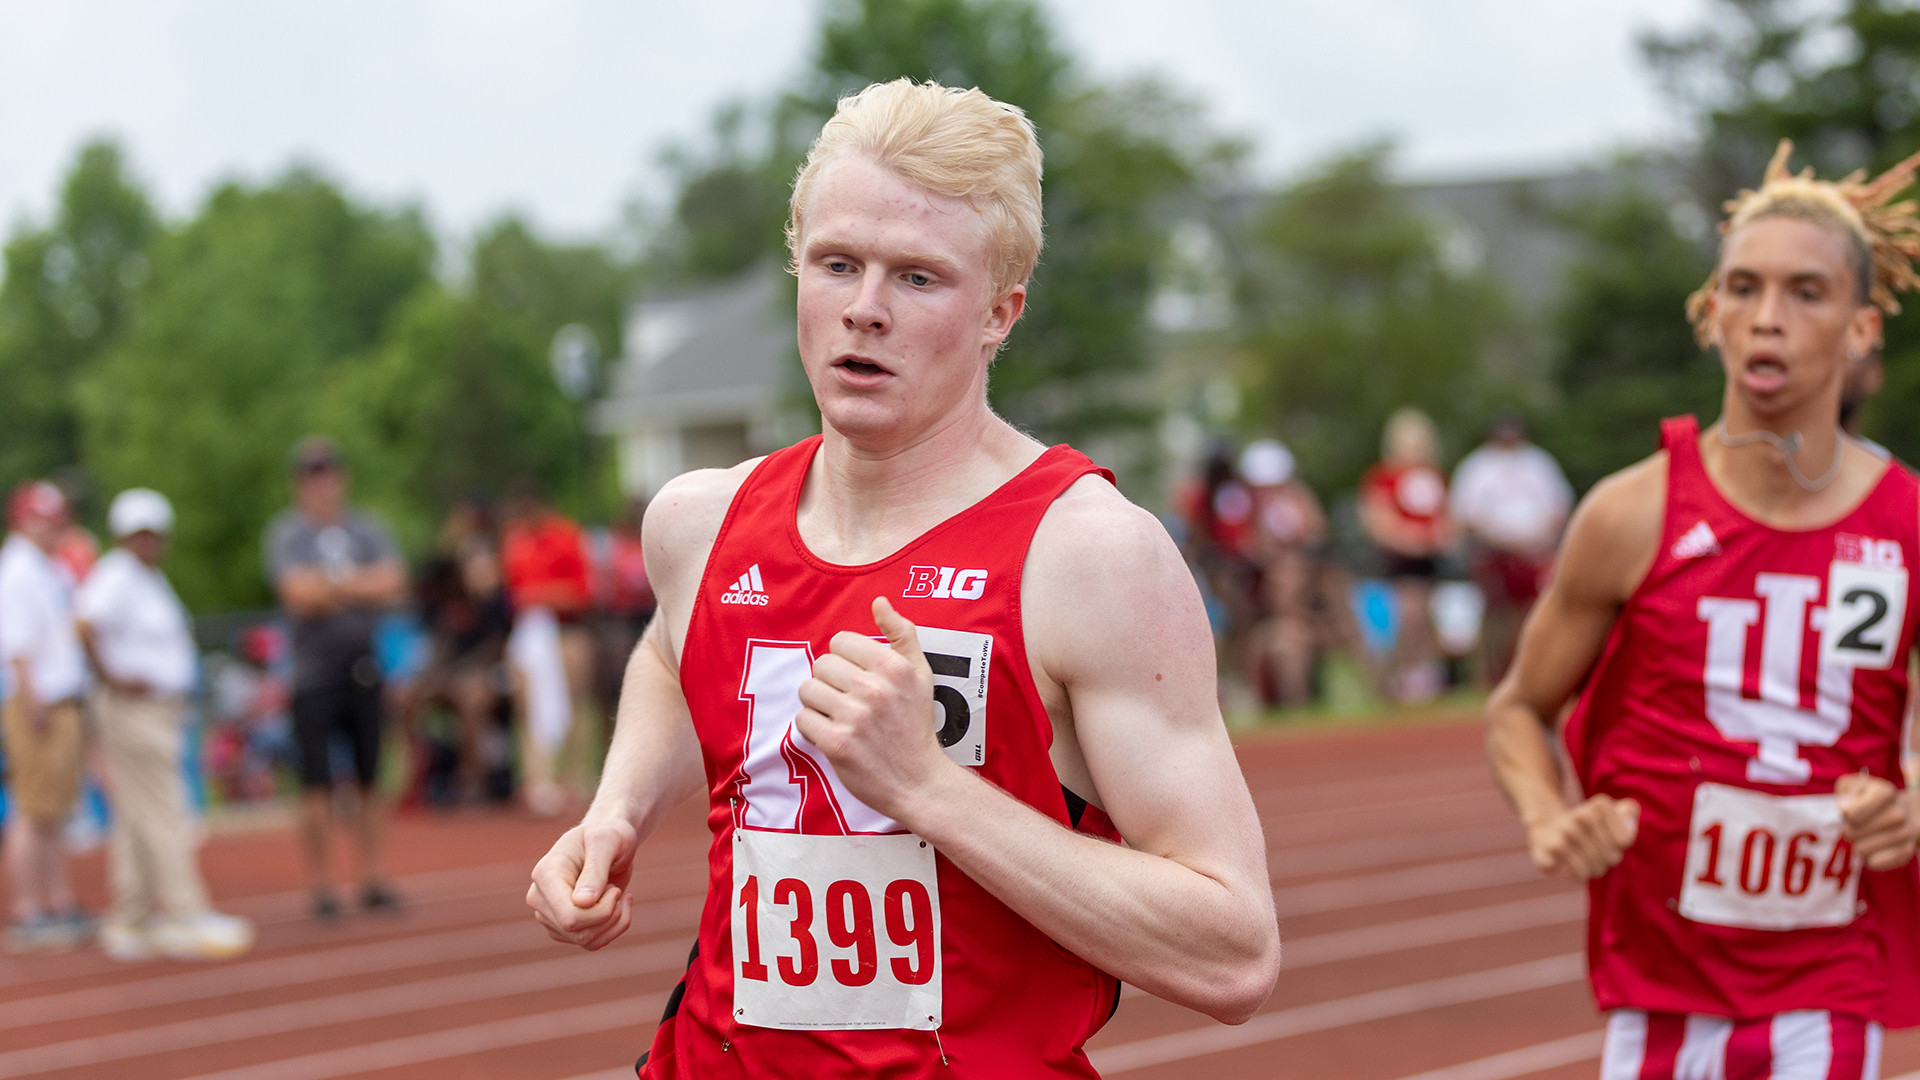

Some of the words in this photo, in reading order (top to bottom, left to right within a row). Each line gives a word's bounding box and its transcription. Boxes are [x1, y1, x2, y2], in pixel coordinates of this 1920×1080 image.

[720, 589, 770, 606] adidas
[902, 565, 988, 600] BIG
[1836, 588, 1888, 654] 2
[974, 744, 982, 761] GILL
[1694, 821, 1853, 897] 1064
[739, 874, 935, 987] 1399
